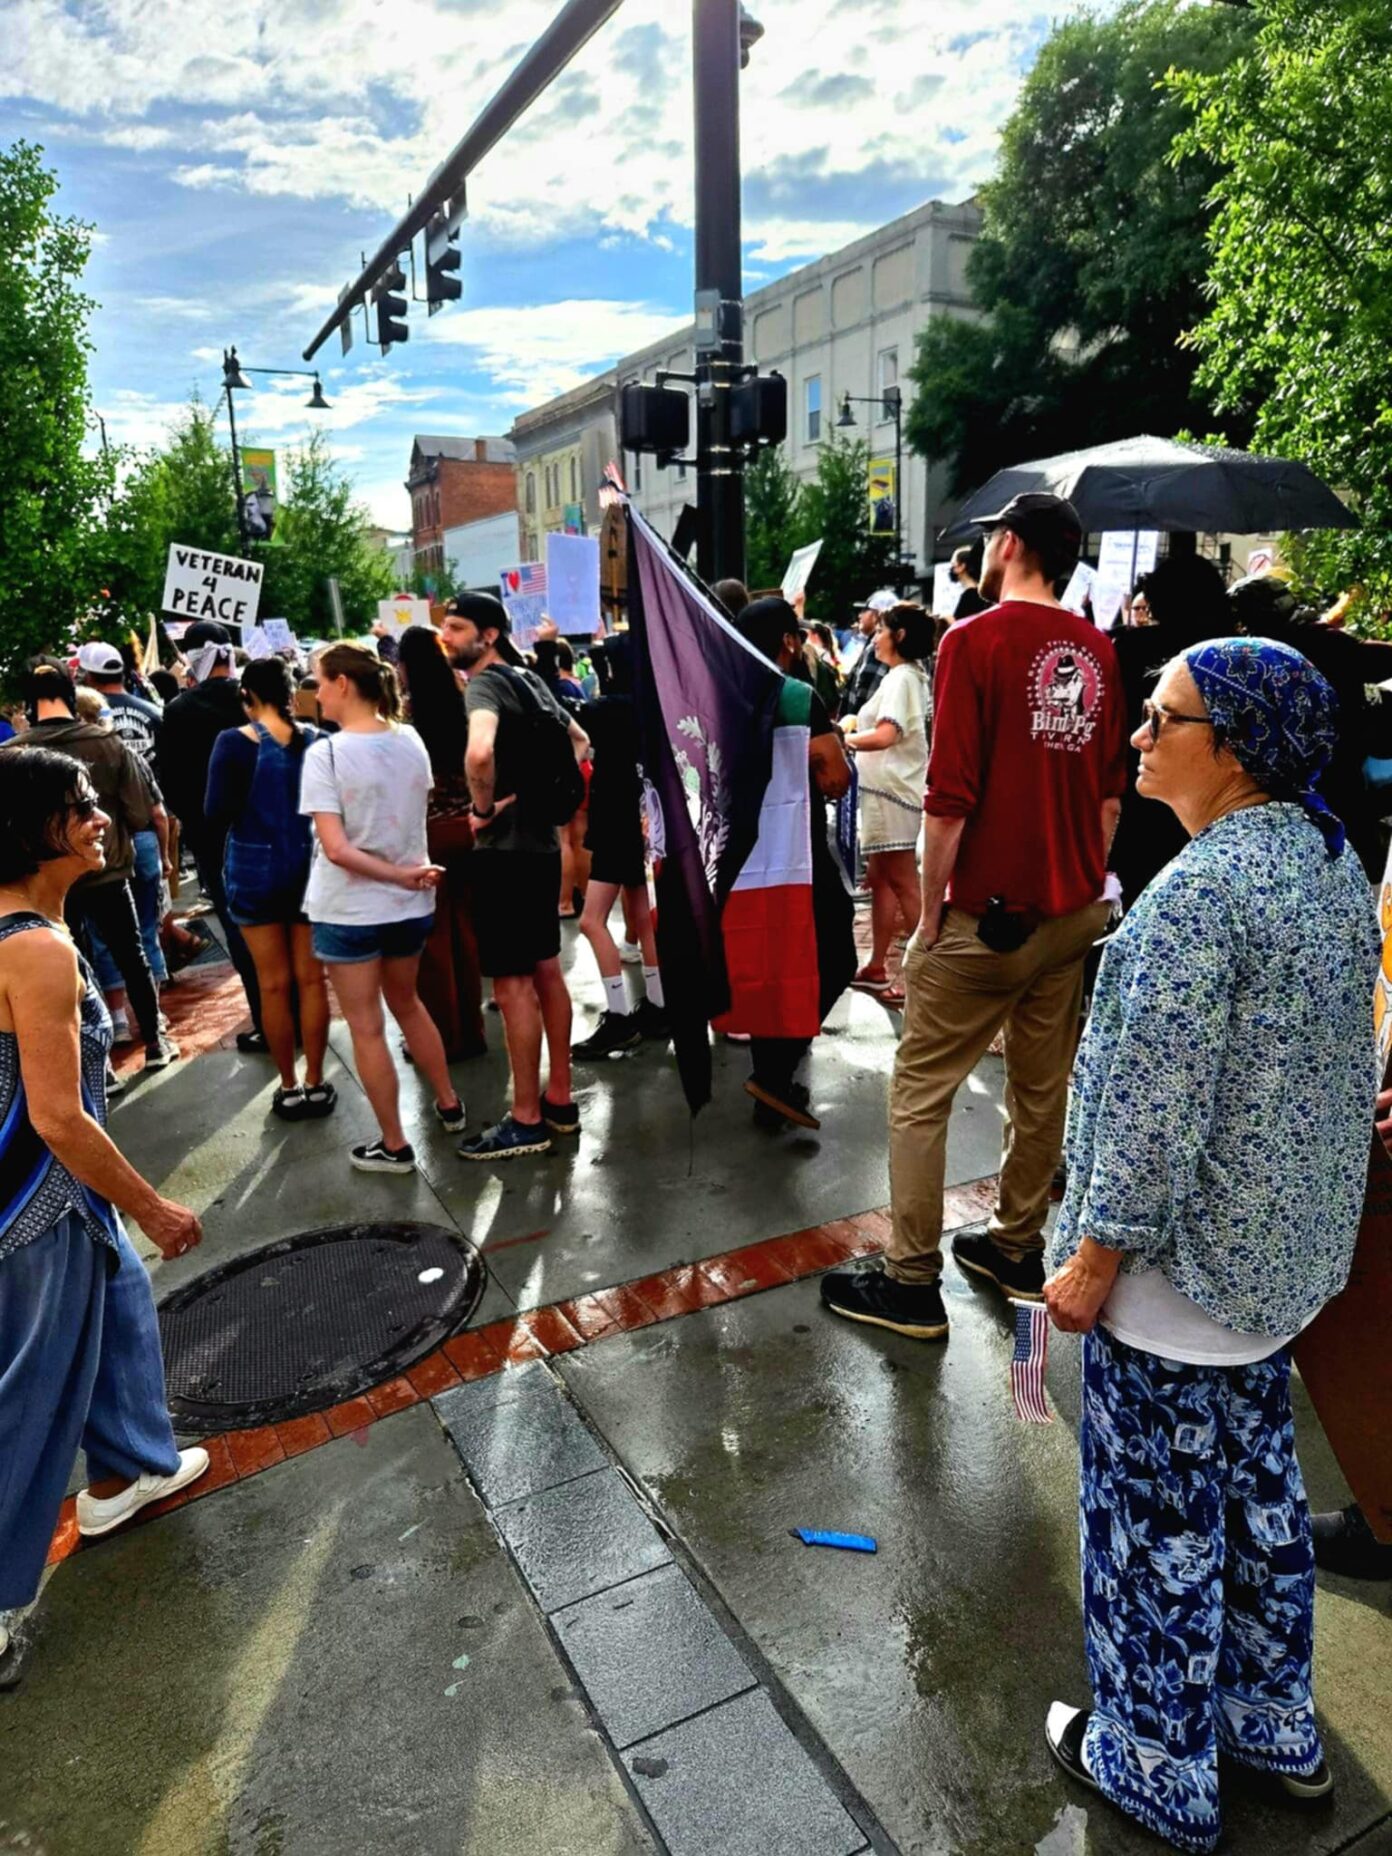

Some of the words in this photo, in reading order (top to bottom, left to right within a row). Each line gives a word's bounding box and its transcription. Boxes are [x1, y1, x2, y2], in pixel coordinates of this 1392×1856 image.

[176, 550, 260, 584] VETERAN
[202, 576, 218, 593] 4
[172, 588, 248, 623] PEACE
